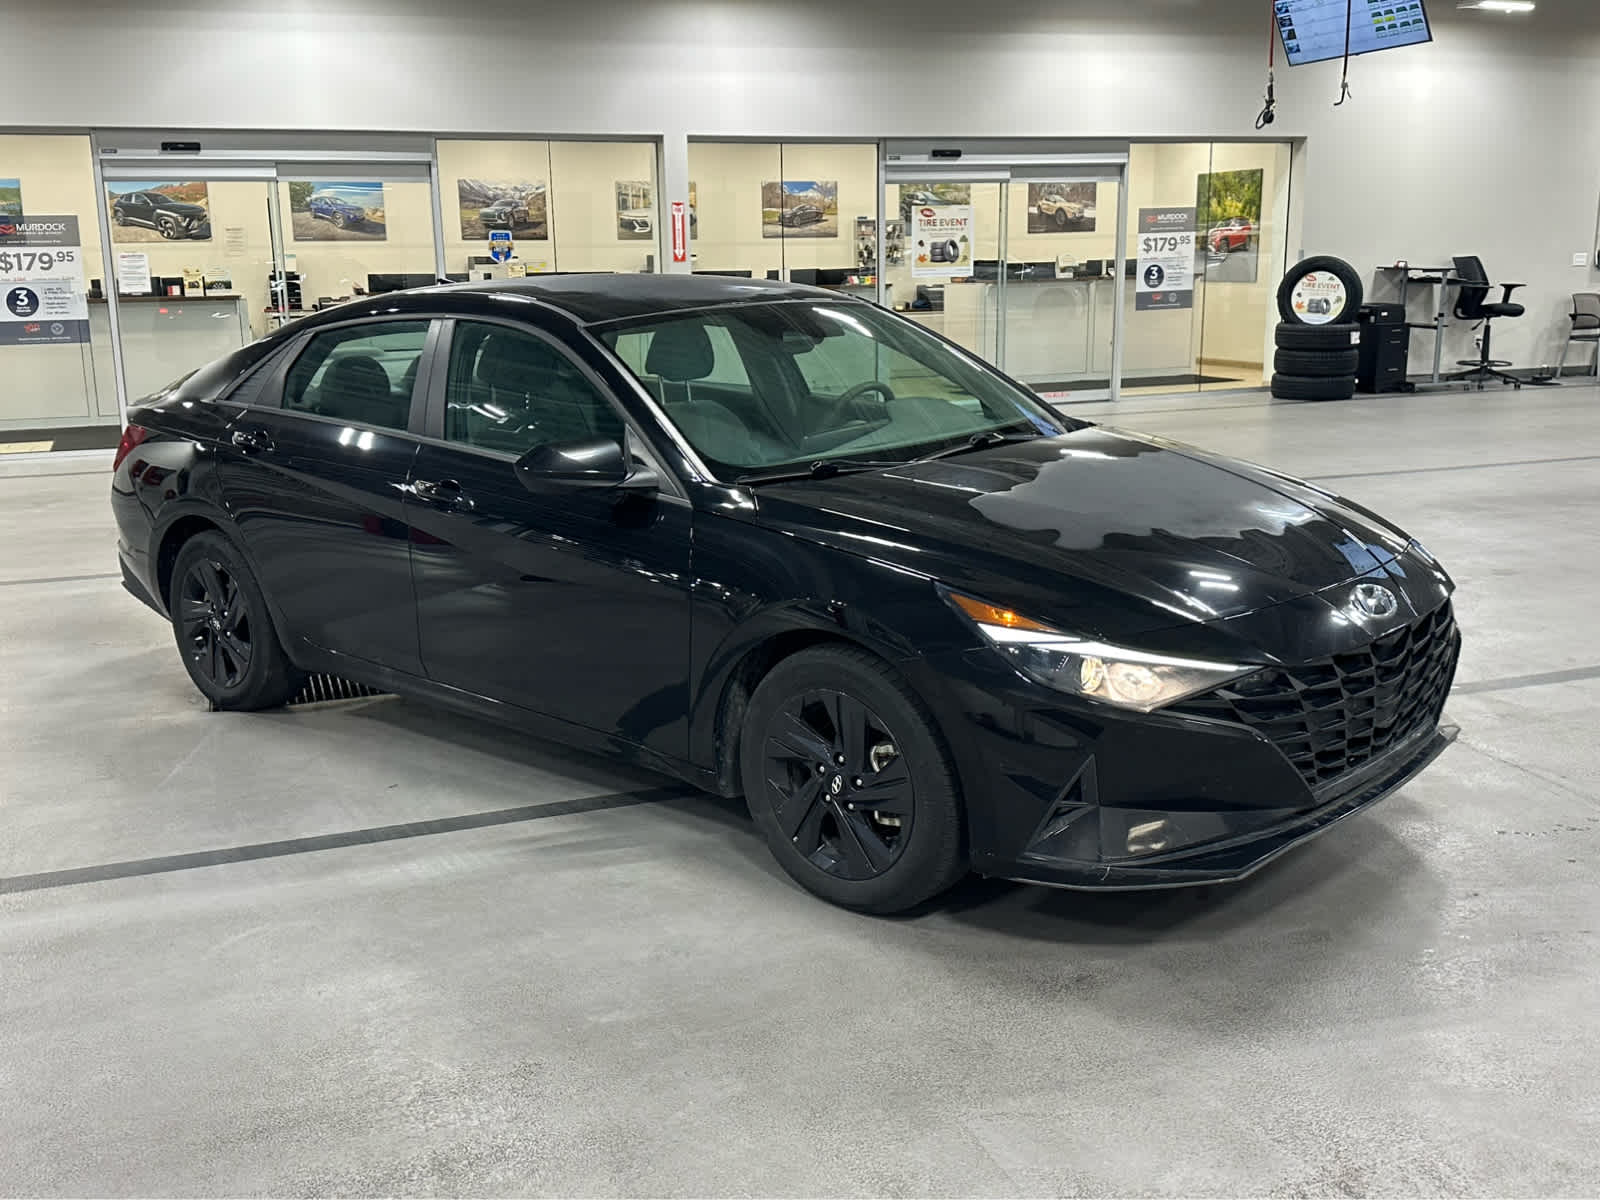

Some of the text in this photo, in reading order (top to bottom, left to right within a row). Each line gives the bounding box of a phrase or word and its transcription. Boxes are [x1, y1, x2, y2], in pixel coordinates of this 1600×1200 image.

[15, 223, 66, 231] MURDOCK
[919, 217, 968, 227] TIRE EVENT
[1143, 235, 1191, 254] $179.95
[0, 251, 74, 274] $179.95
[1150, 266, 1159, 280] 3
[15, 289, 29, 306] 3
